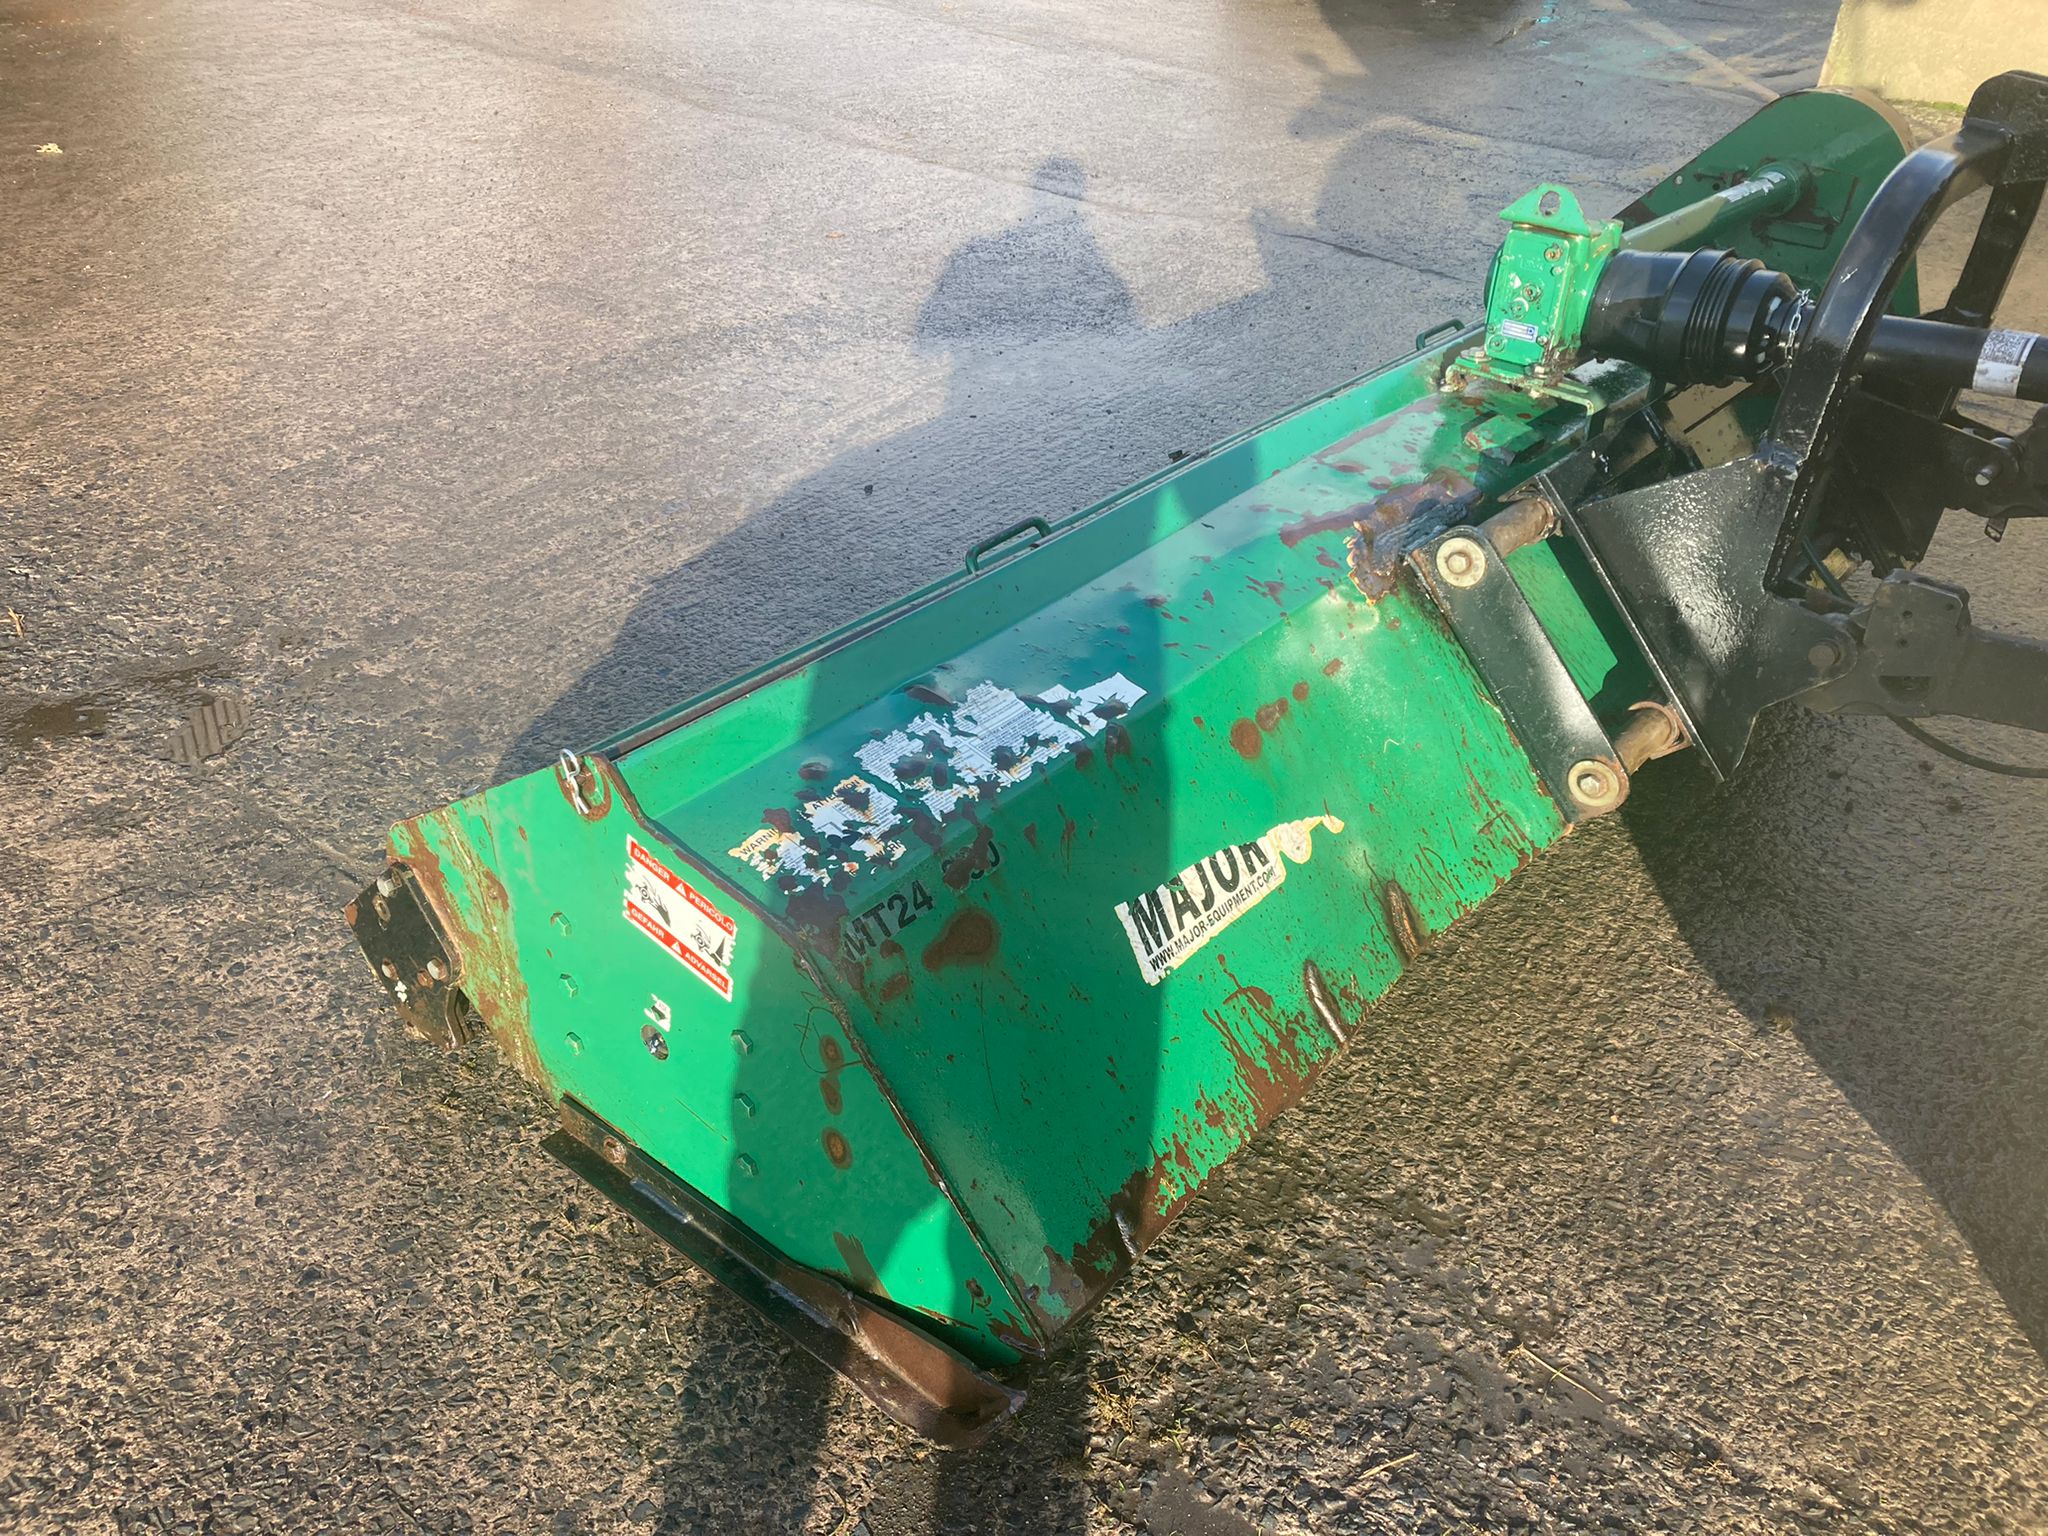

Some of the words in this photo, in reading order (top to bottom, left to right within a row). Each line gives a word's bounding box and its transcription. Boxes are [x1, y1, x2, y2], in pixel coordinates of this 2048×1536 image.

[633, 846, 671, 882] DANGER
[688, 892, 735, 931] PERICOLO
[843, 879, 934, 962] MT24
[1128, 841, 1270, 957] MAJOR
[631, 907, 666, 939] GEFAHR
[684, 951, 729, 990] ADVARSEL
